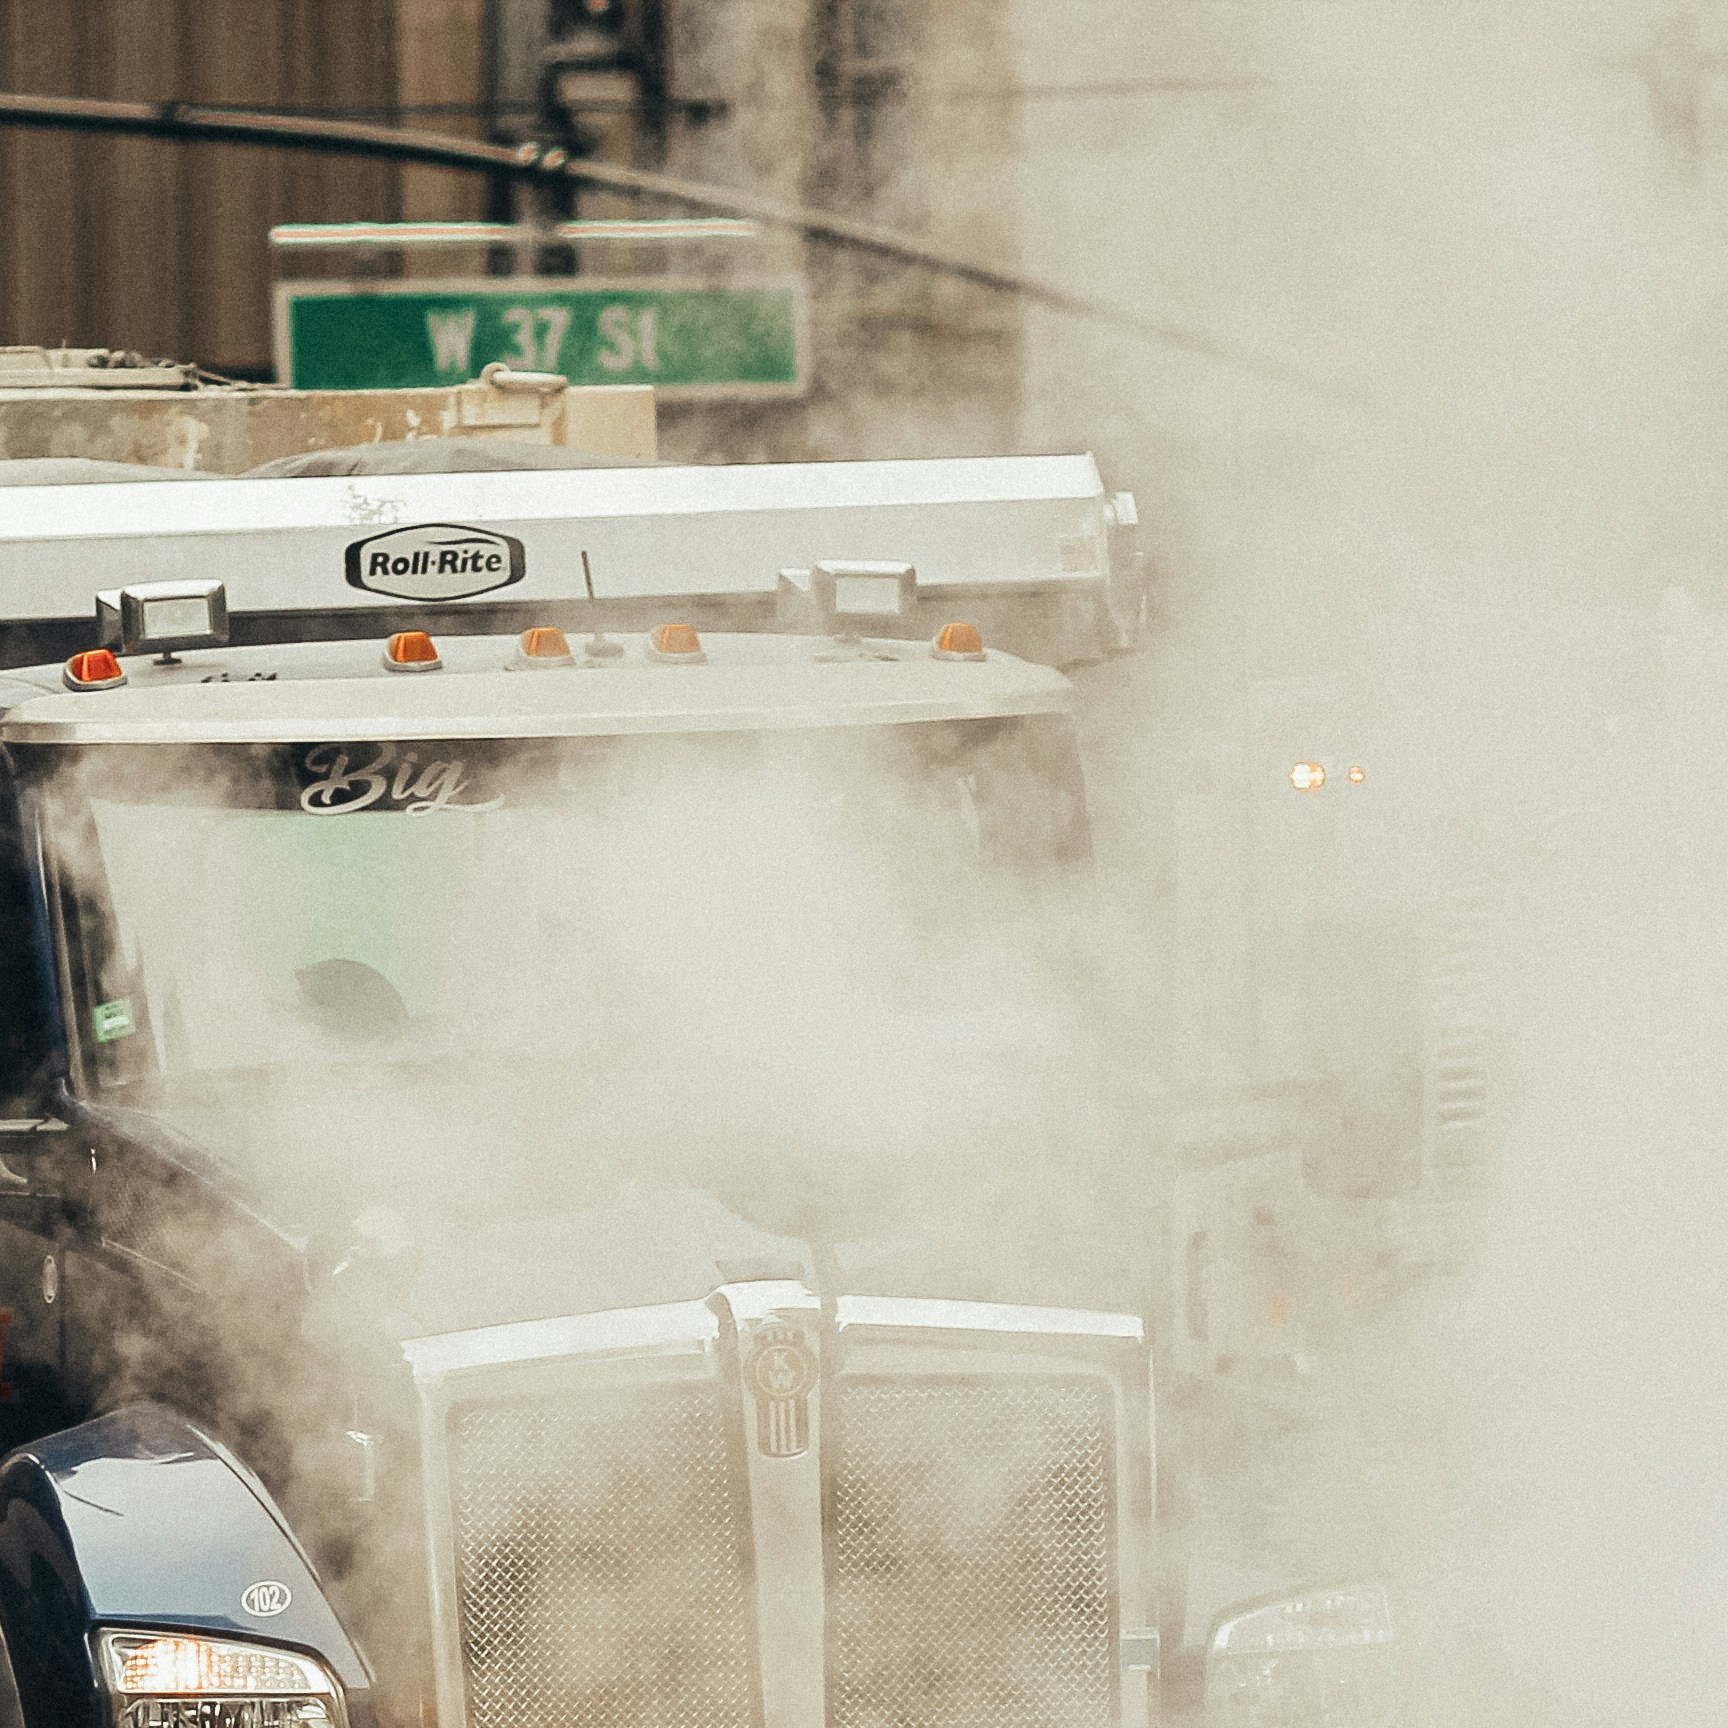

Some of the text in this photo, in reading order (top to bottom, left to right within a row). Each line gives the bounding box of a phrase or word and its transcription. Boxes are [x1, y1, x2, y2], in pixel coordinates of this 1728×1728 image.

[428, 308, 474, 371] W
[502, 308, 569, 372] 37
[301, 743, 504, 817] Big
[249, 1586, 282, 1612] 102
